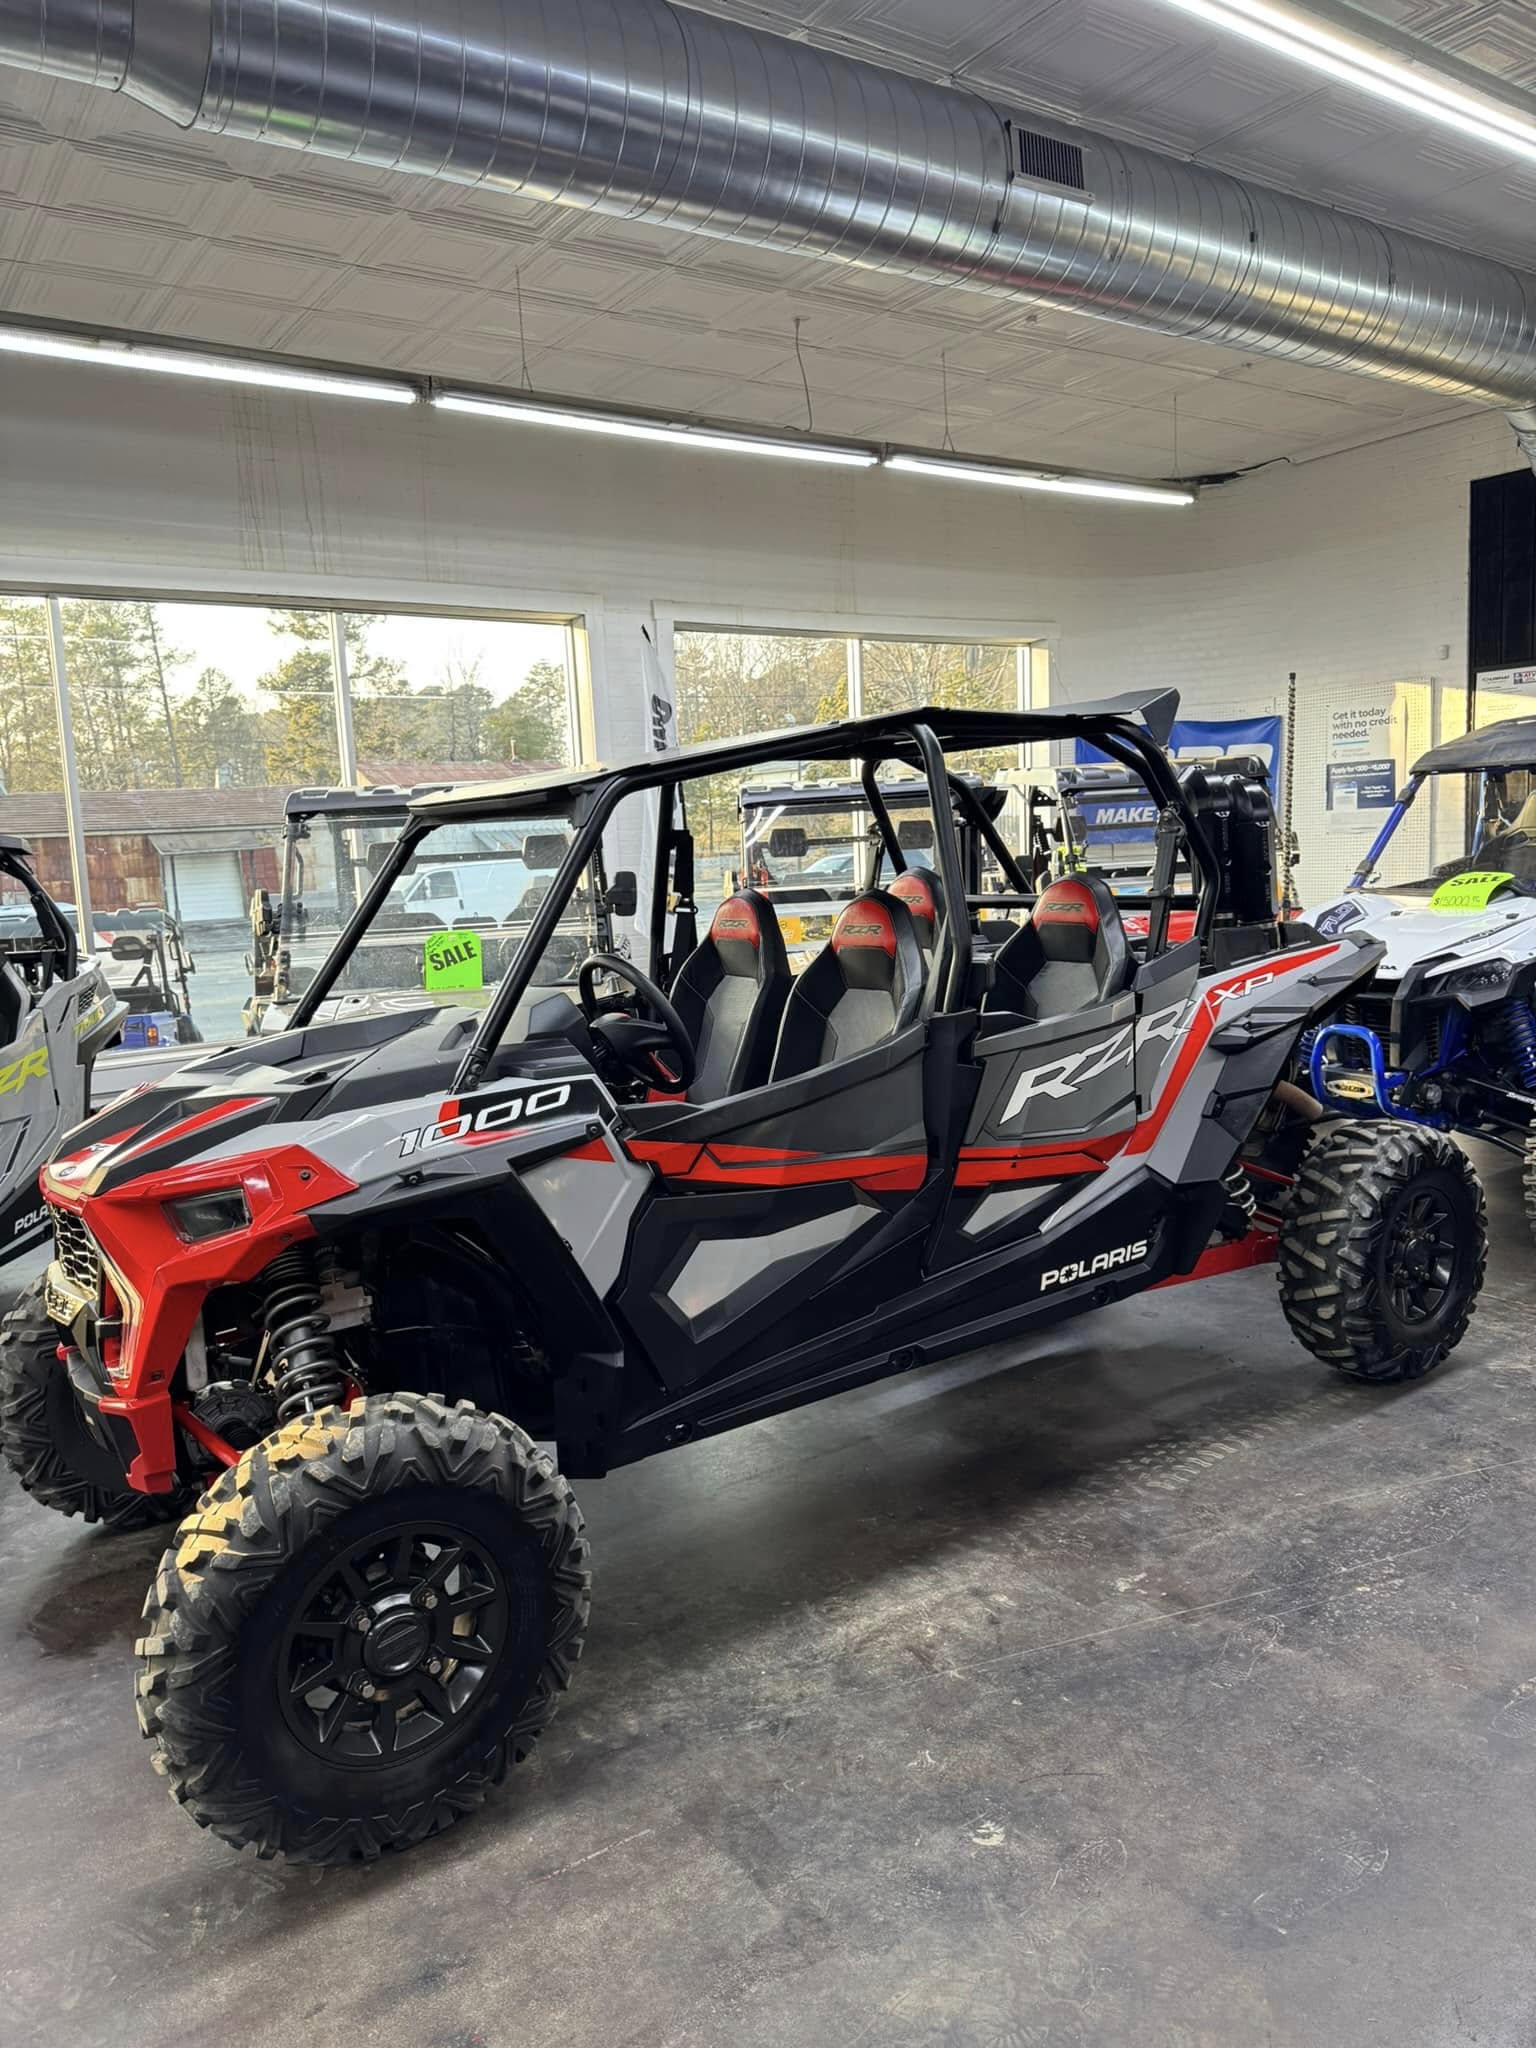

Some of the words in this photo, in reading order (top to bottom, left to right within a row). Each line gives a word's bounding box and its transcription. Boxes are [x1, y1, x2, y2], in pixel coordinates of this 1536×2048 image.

[1332, 711, 1349, 721] Get
[1350, 709, 1357, 719] it
[1359, 707, 1386, 718] today
[1332, 720, 1353, 730] with
[1354, 720, 1367, 728] no
[1369, 714, 1398, 726] credit
[1451, 875, 1505, 887] SALE
[1043, 902, 1086, 912] RZR
[718, 919, 750, 929] RZR
[841, 924, 882, 936] RZR
[429, 940, 477, 971] SALE
[1211, 972, 1274, 1008] XP
[0, 1046, 49, 1095] ZR
[998, 997, 1195, 1127] RZR
[399, 1083, 572, 1158] 1000
[14, 1204, 49, 1235] POLA
[1040, 1239, 1148, 1291] POLARIS
